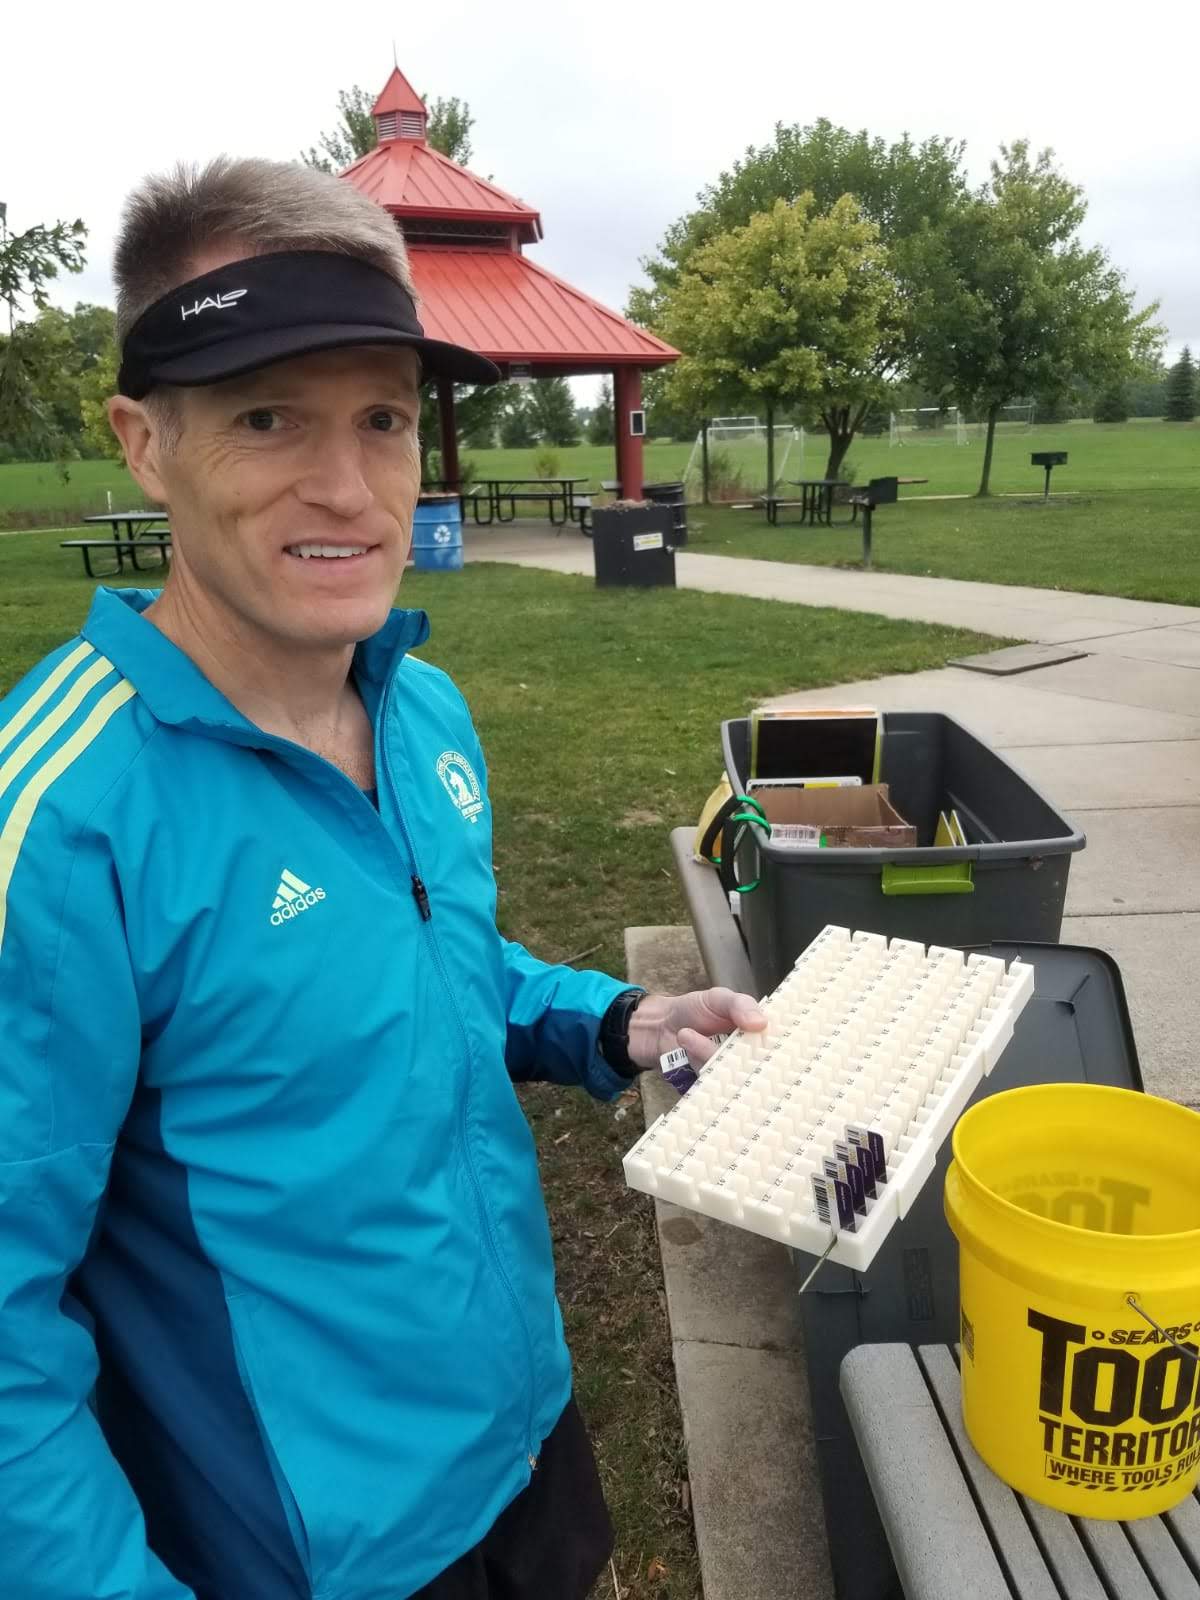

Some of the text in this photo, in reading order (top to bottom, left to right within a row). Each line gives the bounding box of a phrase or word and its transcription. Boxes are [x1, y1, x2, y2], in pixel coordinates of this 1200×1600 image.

[181, 289, 247, 320] HALO
[270, 888, 327, 926] adidas
[1109, 1322, 1193, 1345] SEARS
[1027, 1307, 1200, 1427] TOO
[1050, 1446, 1200, 1485] WHERE TOOLS RUL
